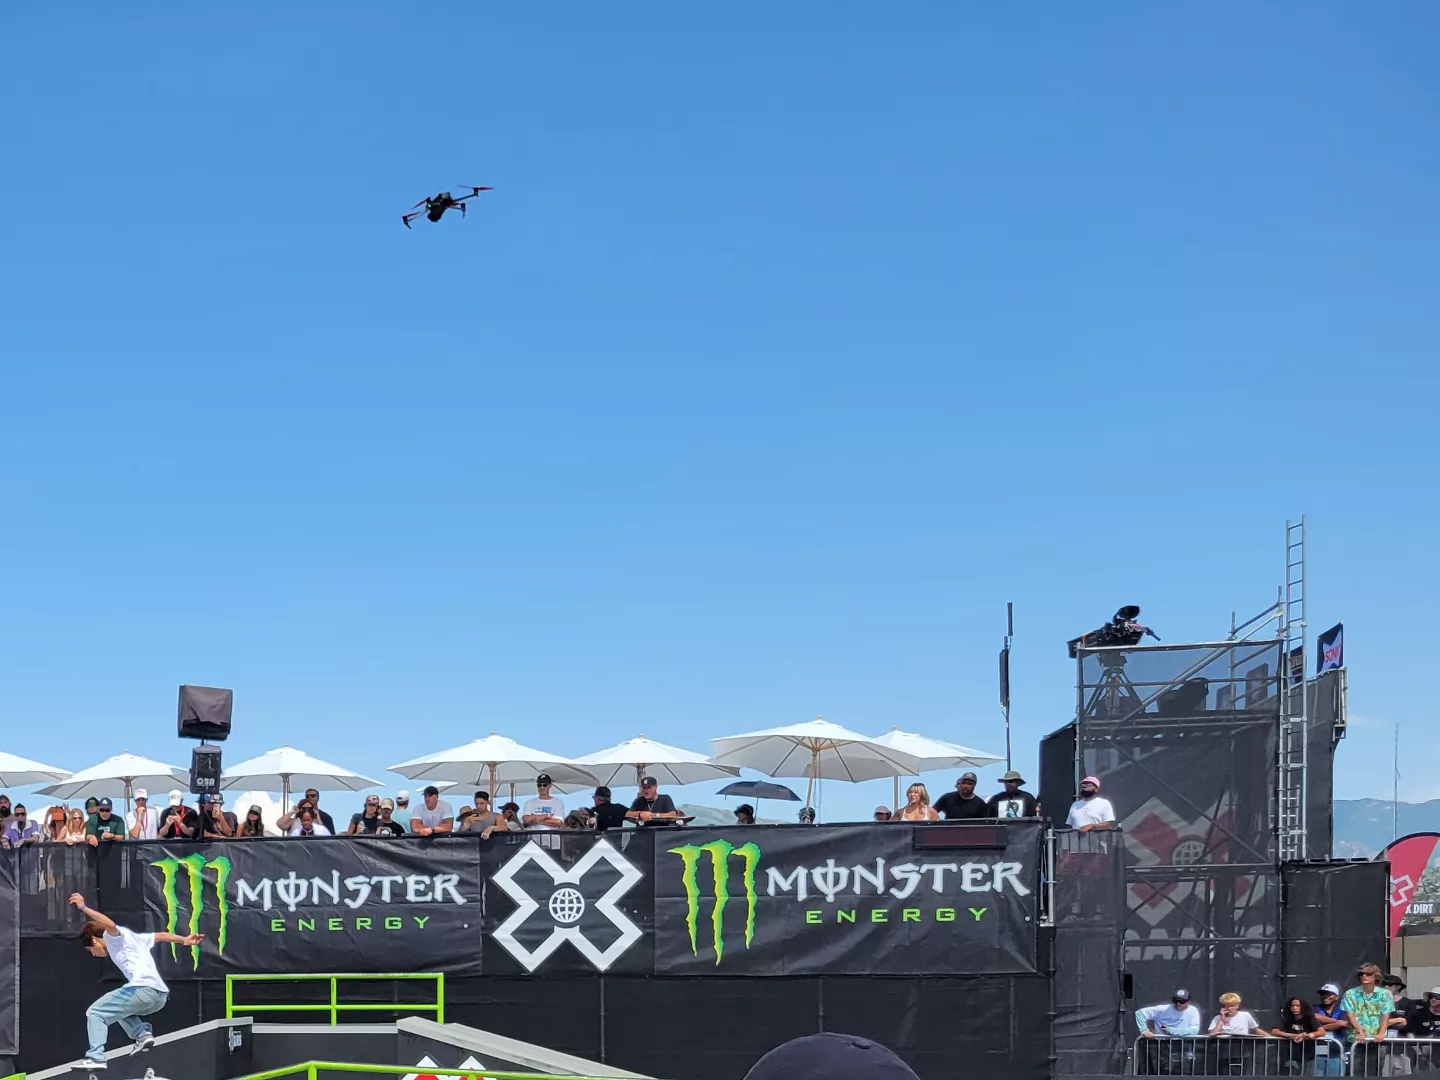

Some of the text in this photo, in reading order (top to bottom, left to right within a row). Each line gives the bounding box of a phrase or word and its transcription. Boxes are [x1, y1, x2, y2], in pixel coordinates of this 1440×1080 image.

[764, 856, 1032, 903] MONSTER
[234, 869, 468, 912] MONSTER
[805, 906, 989, 924] ENERGY
[1413, 903, 1434, 914] DIRT
[270, 915, 431, 933] ENERGY
